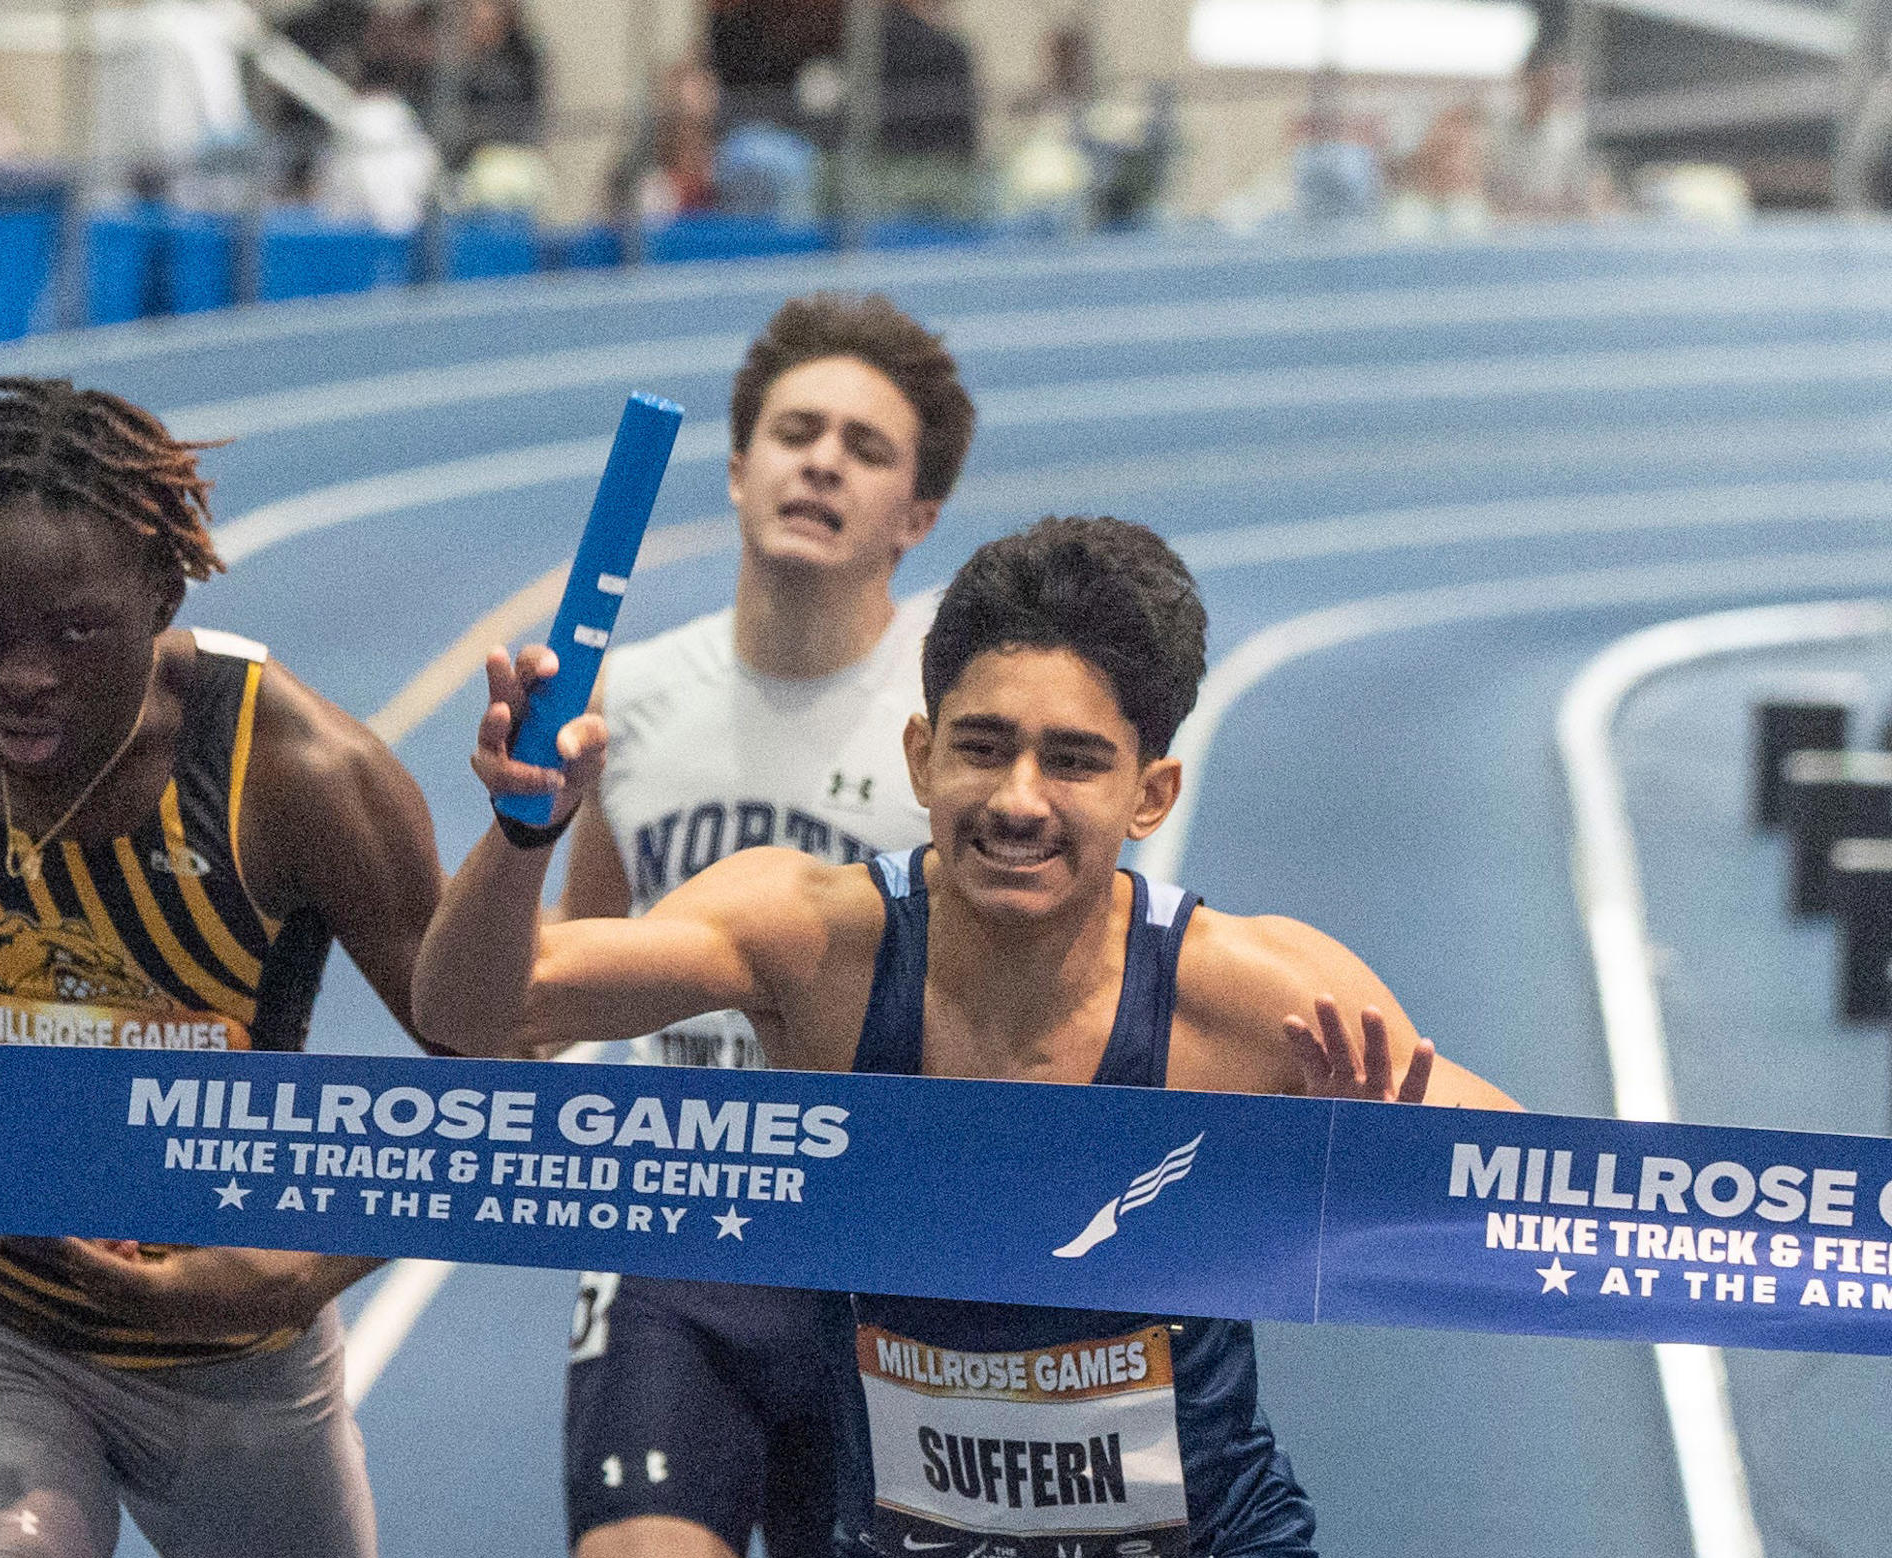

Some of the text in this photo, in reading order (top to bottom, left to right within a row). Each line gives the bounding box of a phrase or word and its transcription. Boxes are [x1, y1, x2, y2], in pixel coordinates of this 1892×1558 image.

[632, 801, 884, 906] NORT
[120, 1021, 228, 1051] GAMES
[127, 1078, 851, 1159] MILLROSE GAMES
[164, 1137, 805, 1203] NIKE TRACK & FIELD CENTER
[1448, 1142, 1858, 1227] MILLROSE
[275, 1186, 687, 1235] AT THE ARMORY
[1486, 1212, 1892, 1276] NIKE TRACK & FIE
[1599, 1267, 1660, 1298] AT
[1684, 1271, 1777, 1304] THE
[876, 1337, 1148, 1392] MILLROSE GAMES
[918, 1425, 1126, 1508] SUFFERN
